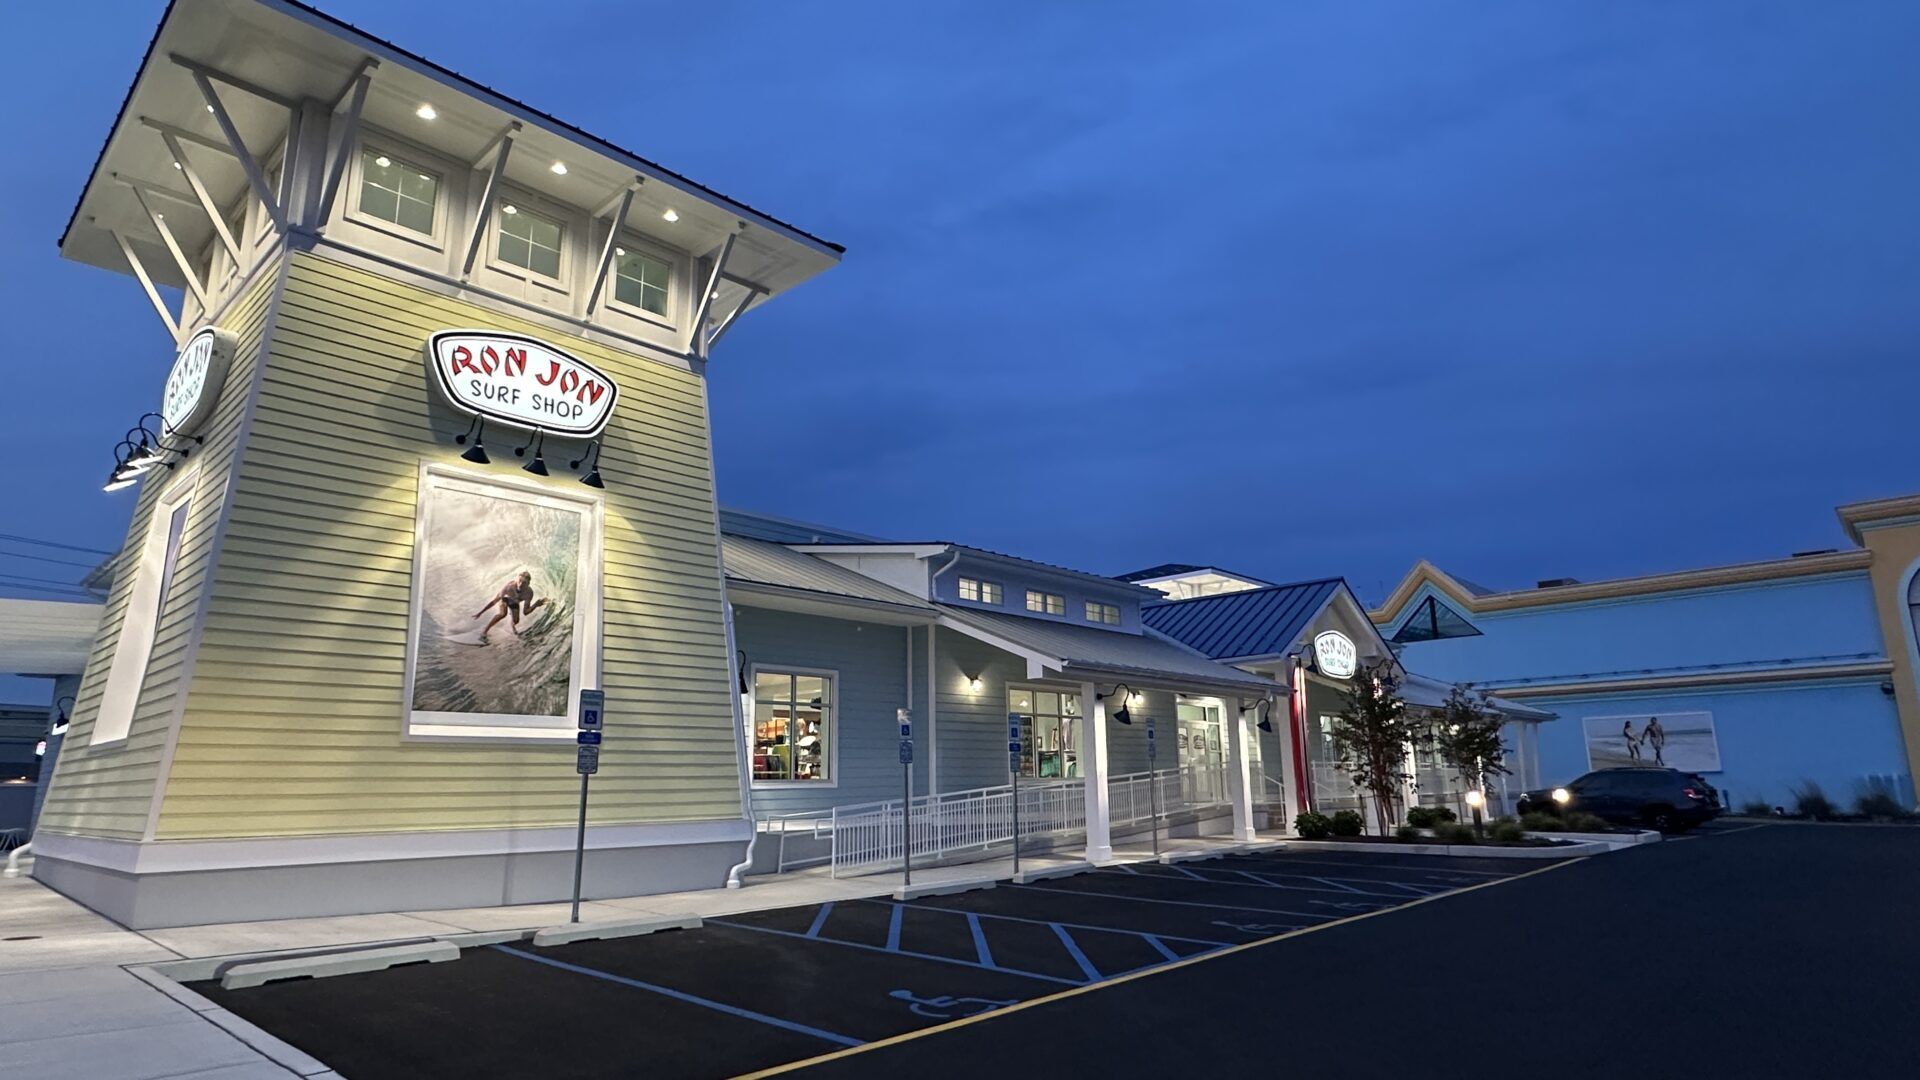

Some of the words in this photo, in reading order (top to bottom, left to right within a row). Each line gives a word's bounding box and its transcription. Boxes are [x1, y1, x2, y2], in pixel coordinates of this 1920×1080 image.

[452, 345, 527, 377] RON
[535, 360, 605, 406] JON
[470, 379, 521, 405] SURF
[532, 393, 583, 420] SHOP
